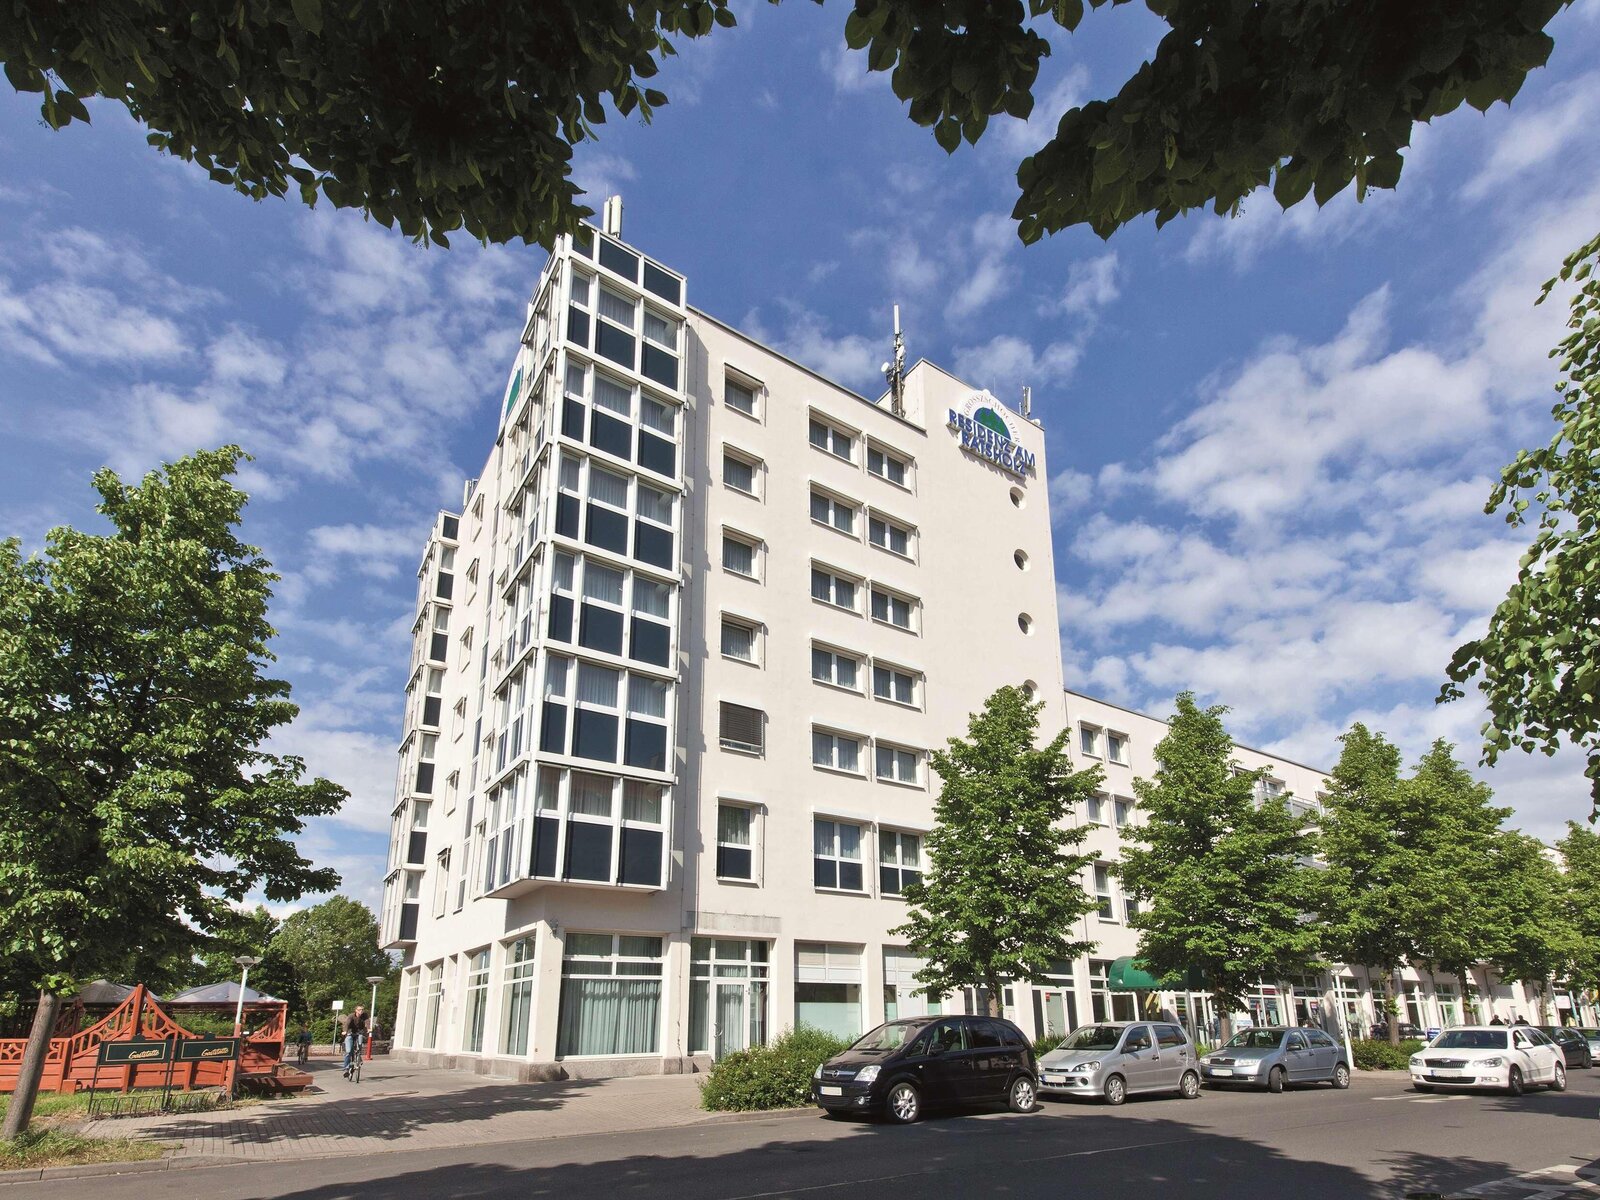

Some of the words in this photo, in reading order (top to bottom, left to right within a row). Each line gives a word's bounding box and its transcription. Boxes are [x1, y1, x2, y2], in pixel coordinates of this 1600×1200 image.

[948, 408, 1012, 453] RESIDENZ
[1015, 445, 1036, 467] AM
[961, 430, 1026, 475] RATSHOLZ
